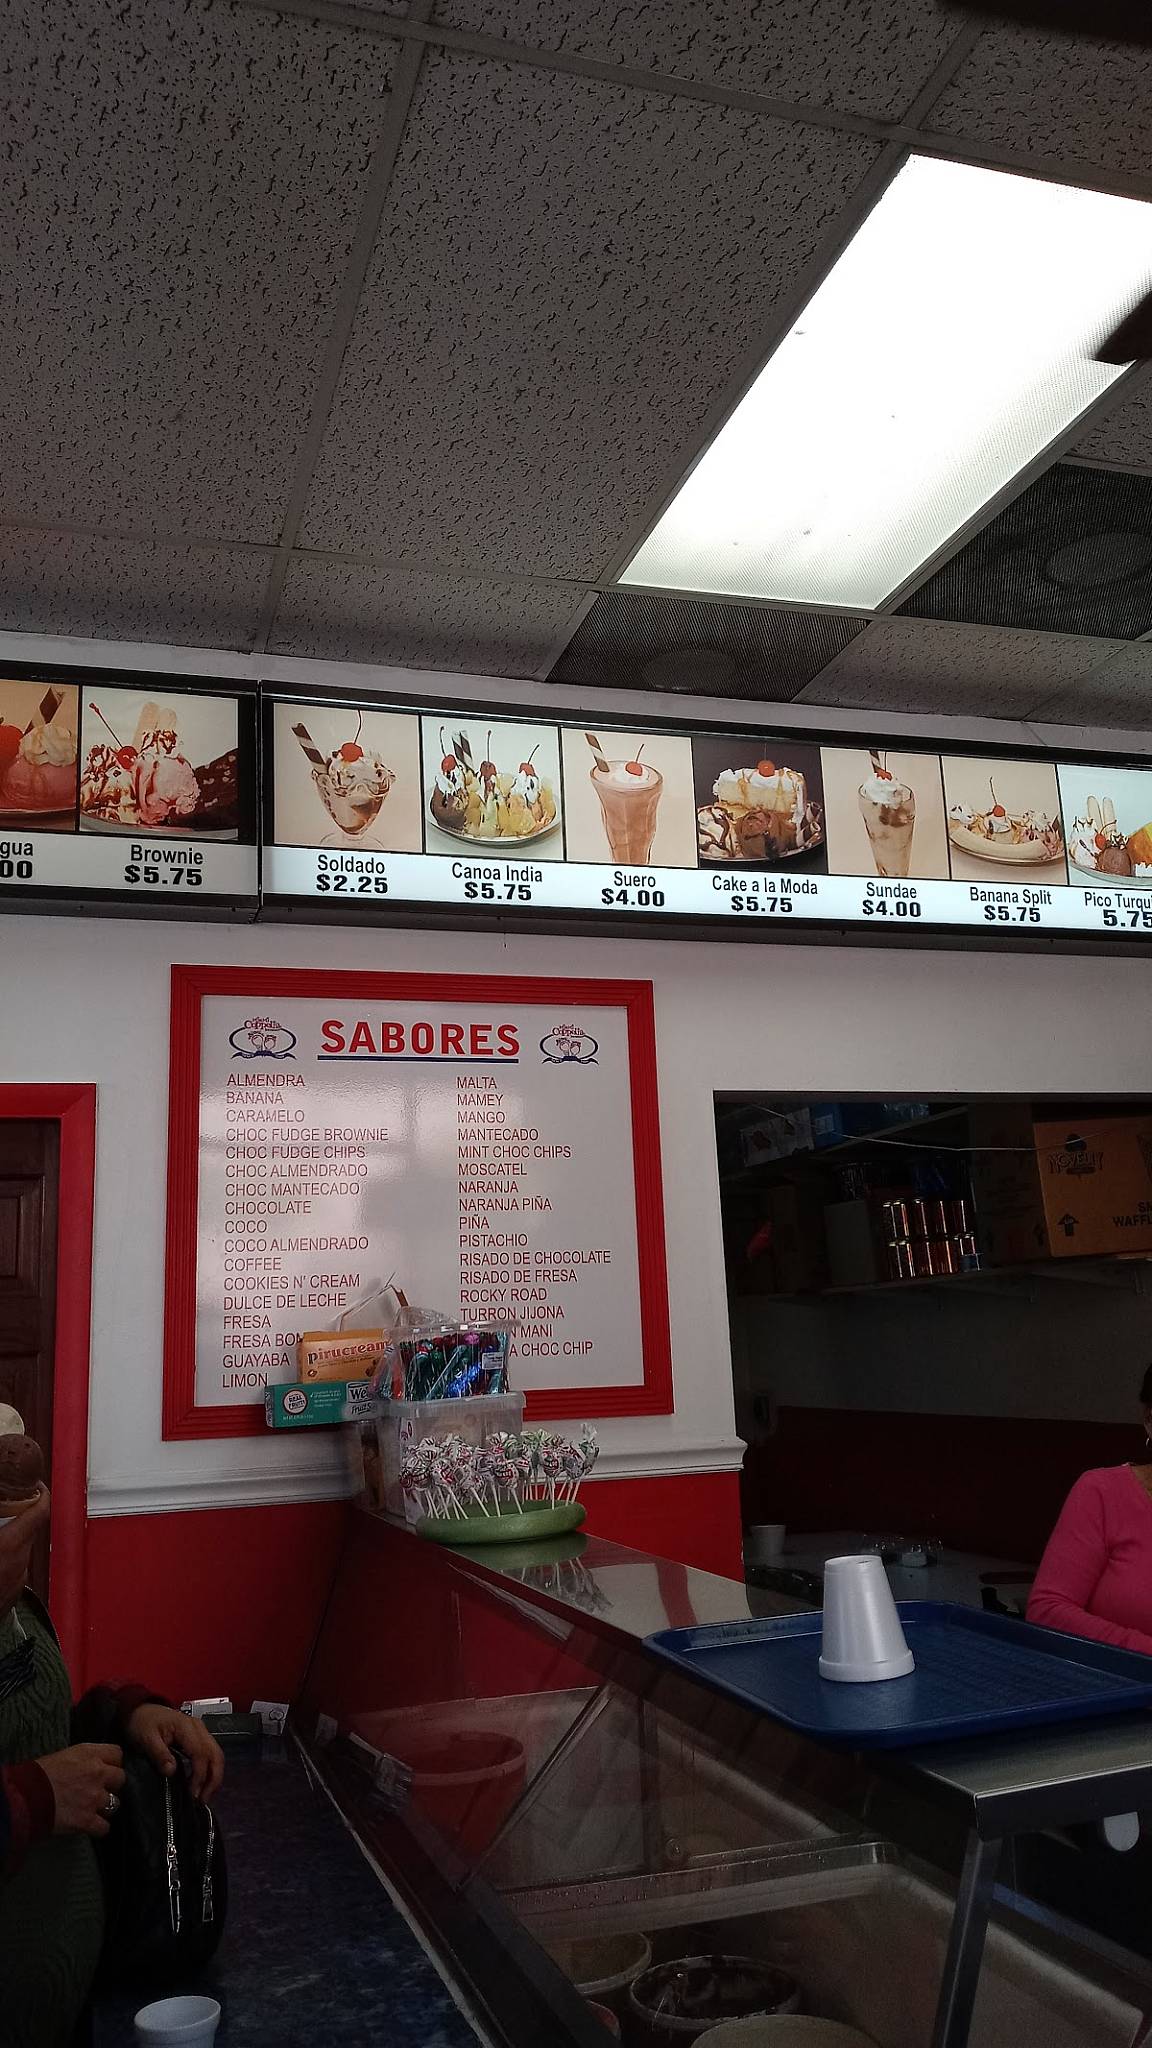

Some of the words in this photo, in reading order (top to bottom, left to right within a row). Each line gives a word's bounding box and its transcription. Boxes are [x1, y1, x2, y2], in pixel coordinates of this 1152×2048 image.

[131, 844, 204, 865] Brownie
[317, 854, 385, 875] Soldado
[452, 862, 501, 881] Canoa
[506, 864, 543, 883] India
[124, 864, 203, 887] $5.75
[316, 873, 388, 894] $2.25
[613, 870, 657, 888] Suero
[464, 881, 532, 901] $5.75
[712, 875, 748, 892] Cake
[752, 880, 760, 892] a
[764, 877, 776, 893] la
[780, 878, 818, 895] Moda
[866, 882, 917, 899] Sundae
[601, 888, 665, 907] $4.00
[731, 896, 793, 913] $5.75
[970, 887, 1019, 904] Banana
[1023, 889, 1052, 906] Split
[1084, 891, 1112, 908] Pico
[1114, 893, 1152, 912] Turqu
[862, 899, 921, 918] $4.00
[984, 905, 1041, 923] $5.75
[1103, 909, 1152, 928] 5.75
[321, 1020, 520, 1056] SABORES
[227, 1074, 305, 1087] ALMENDRA
[456, 1076, 498, 1089] MALTA
[226, 1091, 284, 1104] BANANA
[457, 1093, 504, 1106] MAMEY
[226, 1109, 305, 1122] CARAMELO
[457, 1111, 506, 1124] MANGO
[226, 1128, 267, 1141] CHOC
[272, 1128, 320, 1141] FUDGE
[323, 1128, 389, 1141] BROWNIE
[457, 1128, 539, 1141] MANTECADO
[226, 1146, 267, 1159] CHOC
[271, 1146, 320, 1159] FUDGE
[323, 1145, 366, 1159] CHIPS
[458, 1145, 489, 1159] MINT
[492, 1145, 530, 1158] CHOC
[533, 1145, 572, 1158] CHIPS
[225, 1164, 267, 1178] CHOC
[270, 1163, 368, 1177] ALMENDRADO
[458, 1162, 528, 1176] MOSCATEL
[225, 1183, 267, 1197] CHOC
[271, 1182, 360, 1196] MANTECADO
[458, 1180, 519, 1194] NARANJA
[225, 1201, 311, 1215] CHOCOLATE
[459, 1198, 519, 1211] NARANJA
[522, 1195, 553, 1211] PIÑA
[225, 1220, 267, 1234] COCO
[459, 1214, 490, 1230] PIÑA
[224, 1238, 267, 1253] COCO
[270, 1236, 369, 1251] ALMENDRADO
[459, 1233, 528, 1247] PISTACHIO
[224, 1257, 282, 1272] COFFEE
[459, 1252, 510, 1267] RISADO
[513, 1252, 531, 1265] DE
[534, 1250, 612, 1265] CHOCOLATE
[224, 1276, 289, 1291] COOKIES
[293, 1276, 306, 1289] N'
[310, 1274, 360, 1288] CREAM
[460, 1270, 510, 1285] RISADO
[513, 1270, 531, 1283] DE
[535, 1269, 578, 1283] FRESA
[223, 1295, 272, 1311] DULCE
[277, 1294, 296, 1309] DE
[300, 1292, 347, 1308] LECHE
[460, 1288, 507, 1303] ROCKY
[511, 1288, 547, 1301] ROAD
[223, 1314, 272, 1329] FRESA
[460, 1307, 516, 1322] TURRON
[520, 1306, 565, 1320] JIJONA
[520, 1324, 553, 1338] MANI
[223, 1334, 271, 1349] FRESA
[521, 1342, 560, 1357] CHOC
[562, 1341, 593, 1356] CHIP
[222, 1352, 290, 1368] GUAYABA
[222, 1373, 268, 1388] LIMON
